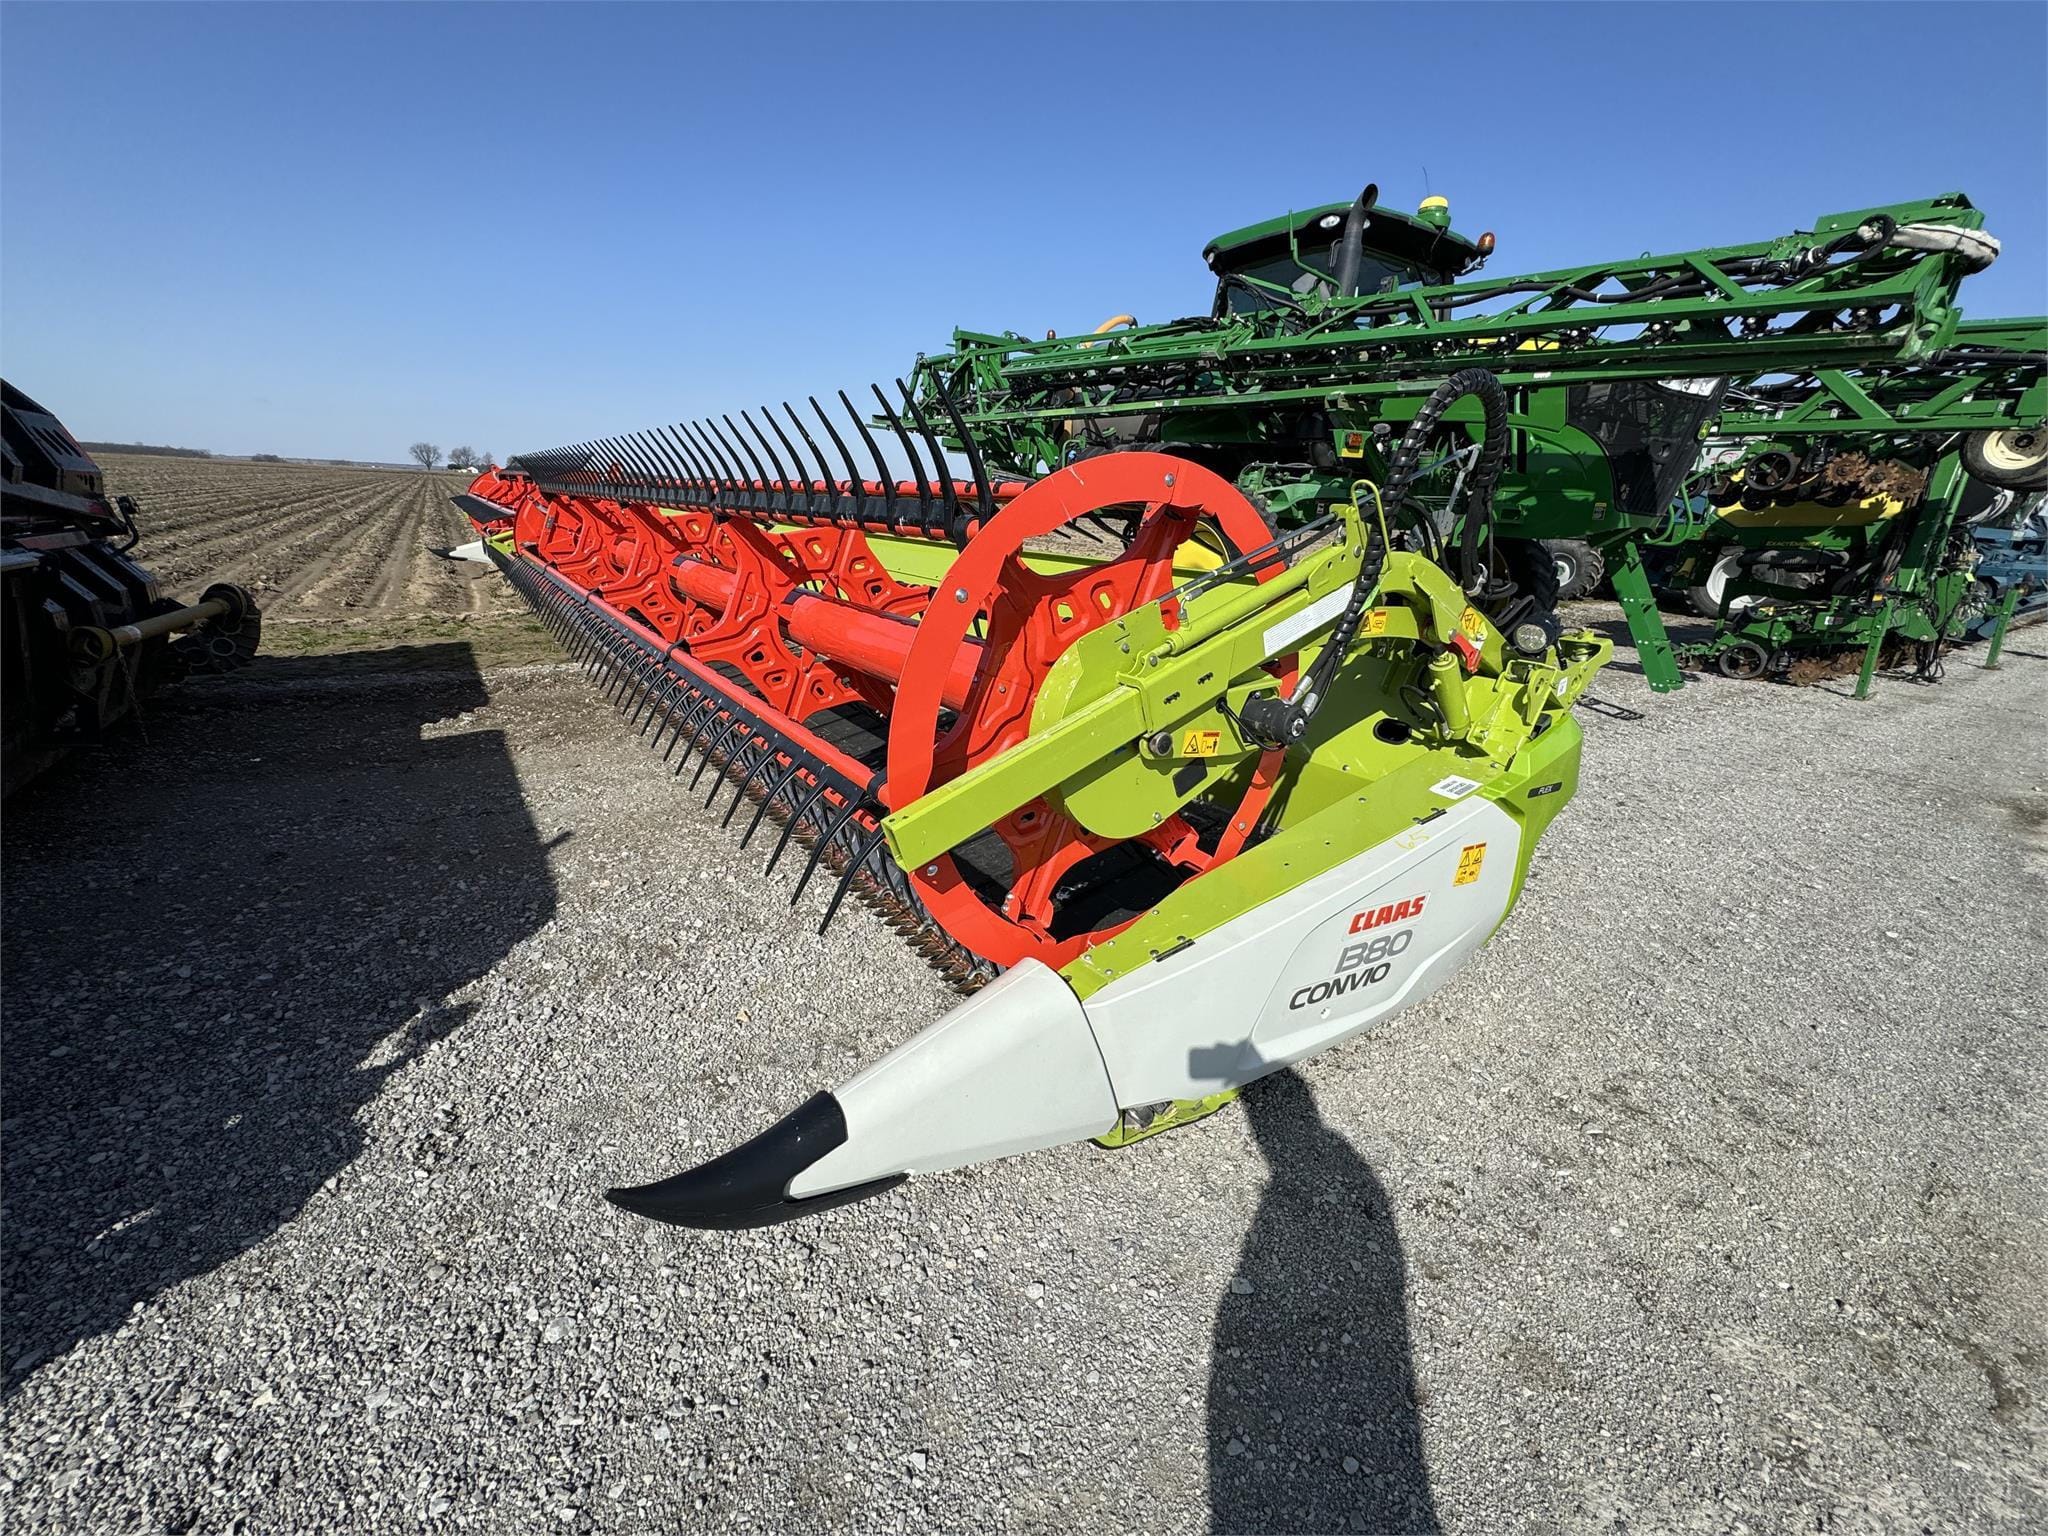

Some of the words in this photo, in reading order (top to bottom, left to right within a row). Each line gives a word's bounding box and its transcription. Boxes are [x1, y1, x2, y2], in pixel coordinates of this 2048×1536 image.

[1537, 785, 1554, 795] FLEX
[1348, 895, 1426, 935] CLAAS
[1334, 929, 1413, 974] B80
[1289, 962, 1391, 1010] CONVIO
